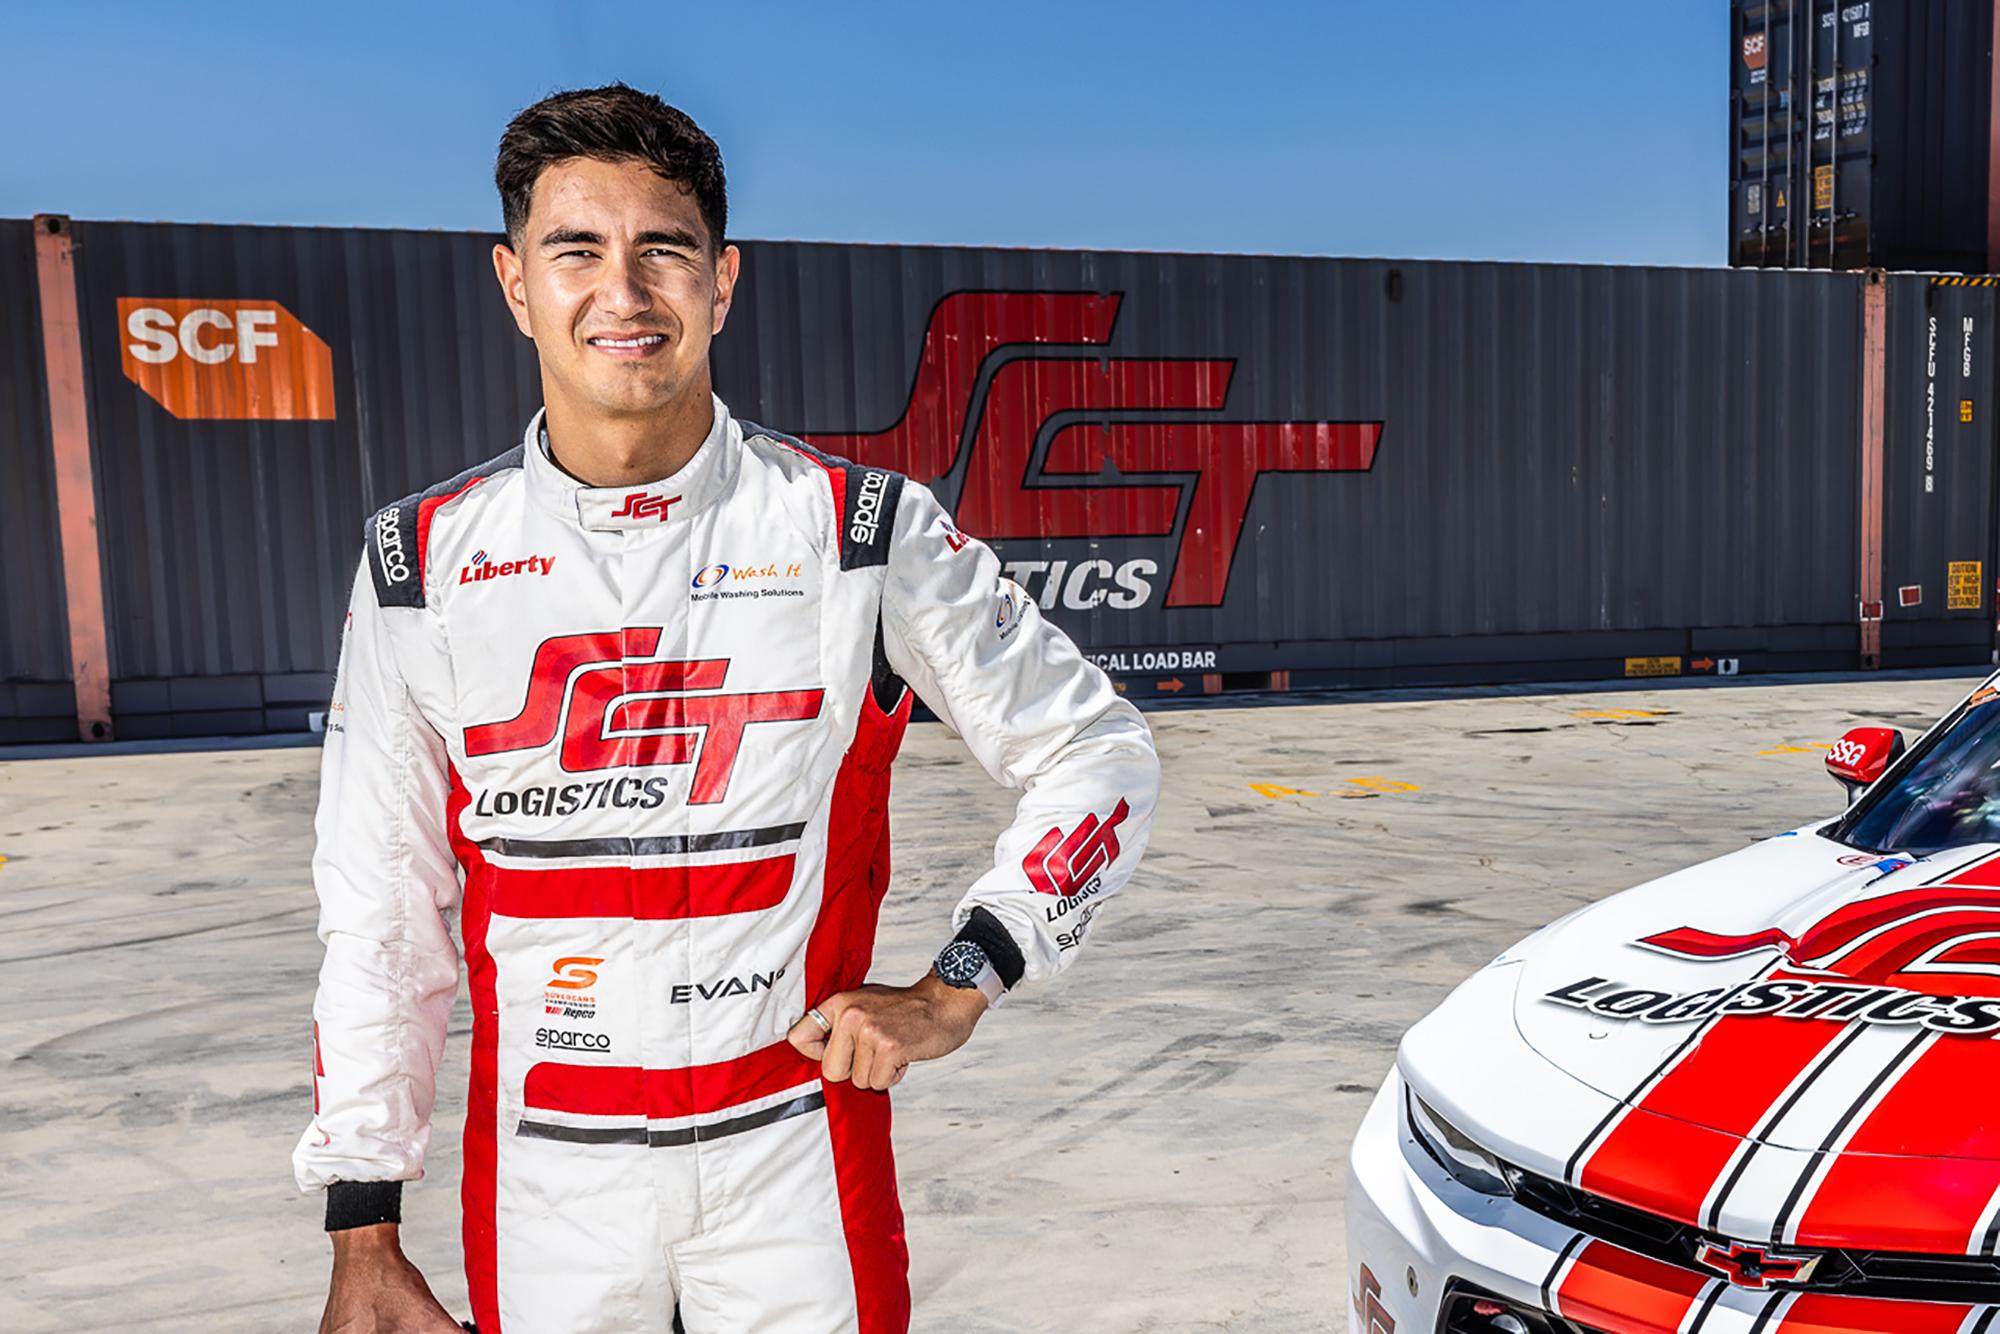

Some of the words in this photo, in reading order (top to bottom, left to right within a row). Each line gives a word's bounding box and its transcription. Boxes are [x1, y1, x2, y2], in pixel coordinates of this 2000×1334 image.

[1744, 35, 1764, 55] SCF
[127, 307, 279, 365] SCF
[611, 491, 682, 522] SCT
[850, 472, 884, 544] sparco
[376, 508, 409, 582] sparco
[459, 554, 556, 585] Liberty
[732, 564, 778, 580] Wash
[786, 563, 802, 578] It
[1004, 559, 1158, 610] TICS
[691, 592, 719, 602] Mobile
[720, 589, 759, 599] Washing
[761, 588, 804, 597] Solutions
[1133, 652, 1180, 670] LOAD
[1182, 651, 1216, 668] BAR
[463, 626, 826, 806] SCT
[1828, 739, 1866, 767] SSG
[475, 776, 668, 817] LOGISTICS
[563, 1006, 596, 1020] Repco
[536, 1027, 611, 1051] sparco
